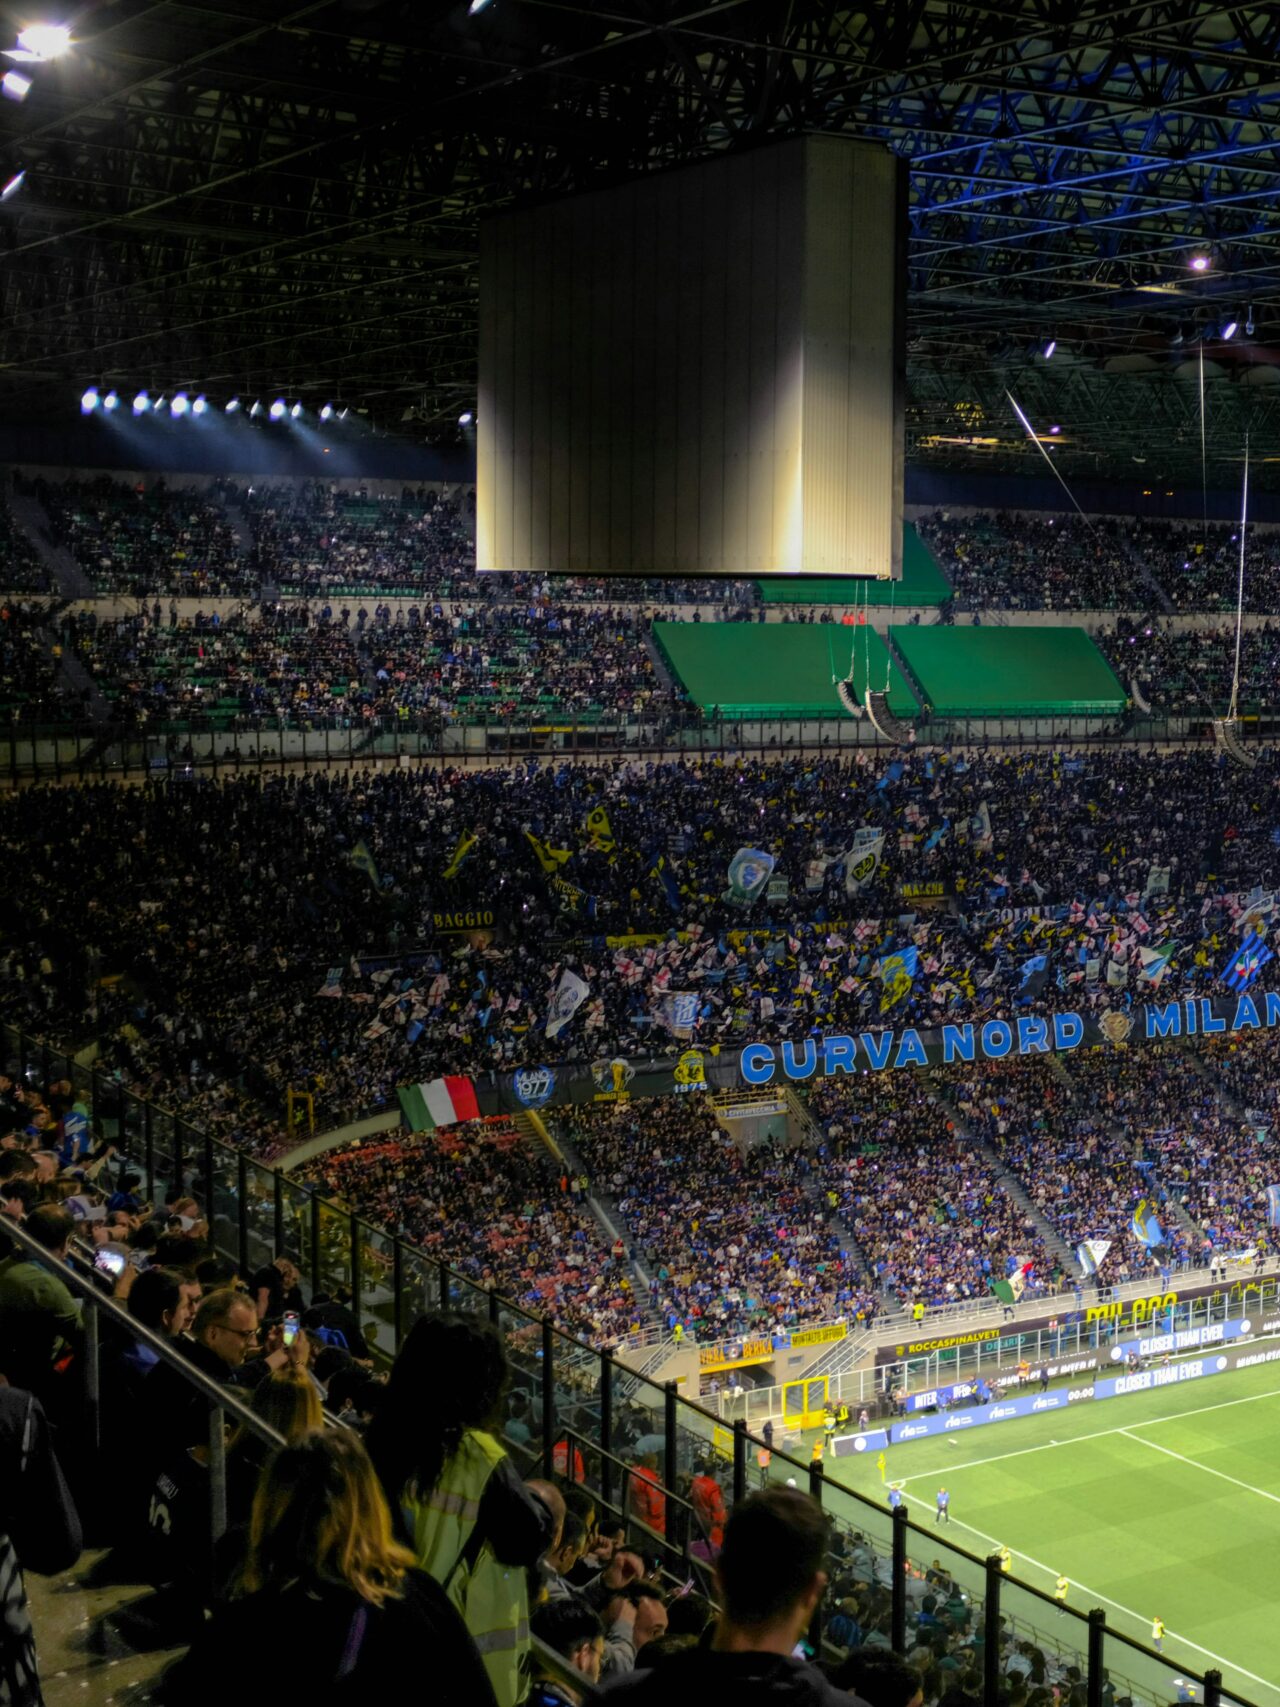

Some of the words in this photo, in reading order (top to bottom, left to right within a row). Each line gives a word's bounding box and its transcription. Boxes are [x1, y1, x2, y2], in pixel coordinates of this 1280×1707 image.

[433, 910, 494, 928] BAGGIO
[740, 1028, 929, 1084] CURVA
[941, 1011, 1084, 1063] NORD
[517, 1079, 551, 1097] 1977
[673, 1082, 708, 1094] 1975
[1086, 1292, 1178, 1326] MILANO
[742, 1339, 773, 1358] BERICA
[908, 1329, 1001, 1354] ROCCASPINALVETI
[1140, 1333, 1173, 1355] CLOSER
[1175, 1328, 1200, 1350] THAN
[1202, 1324, 1224, 1344] EVER
[1115, 1374, 1151, 1394] CLOSER
[1153, 1367, 1178, 1386] THAN
[1179, 1361, 1203, 1380] EVER
[915, 1391, 937, 1409] INTER
[1067, 1387, 1095, 1401] 00:00
[1033, 1397, 1048, 1410] ria
[945, 1415, 961, 1429] ria
[989, 1406, 1005, 1420] ria
[900, 1425, 916, 1438] ria
